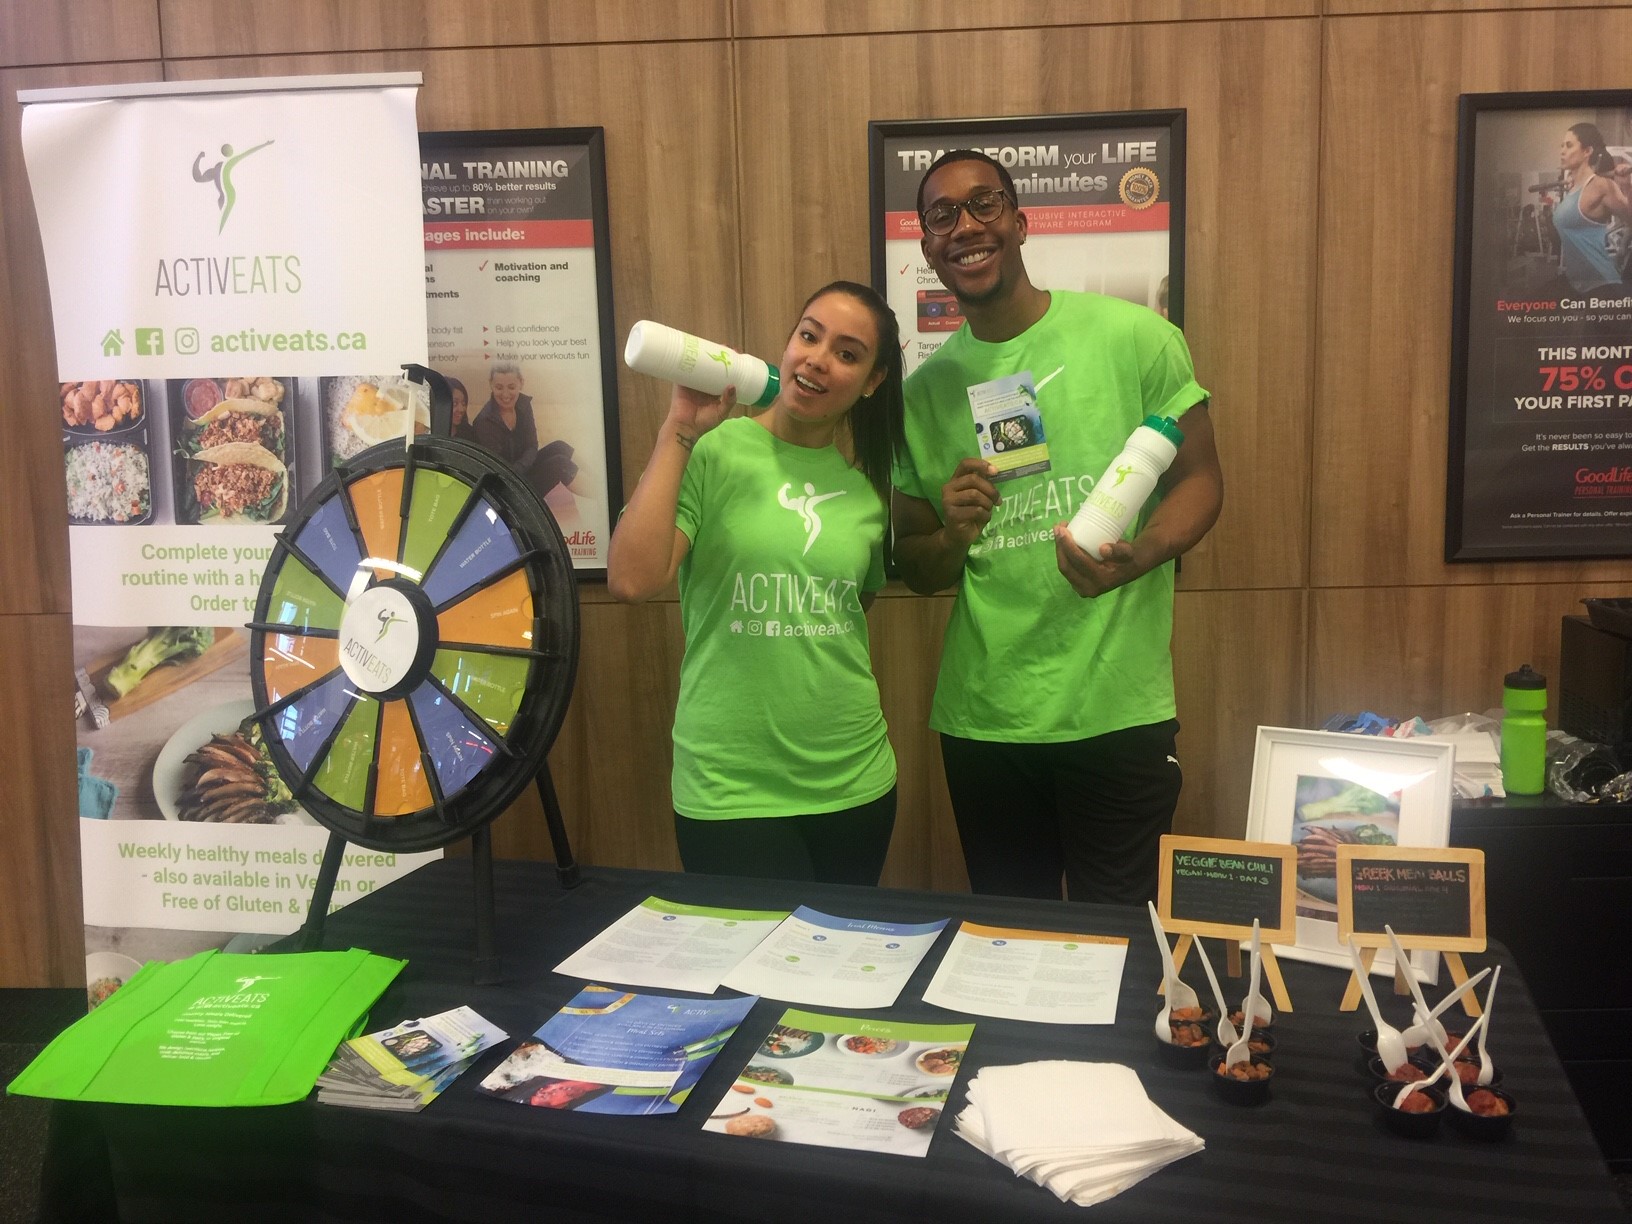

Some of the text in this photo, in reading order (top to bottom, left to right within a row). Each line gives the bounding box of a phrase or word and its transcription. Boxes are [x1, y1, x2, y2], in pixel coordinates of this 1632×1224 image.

[898, 142, 1157, 171] TRFORM your LIFE
[463, 160, 568, 180] TRAINING
[449, 185, 460, 193] up
[462, 184, 470, 192] to
[473, 183, 493, 192] 80%
[495, 183, 523, 191] better
[525, 182, 556, 190] results
[1013, 172, 1108, 194] minutes
[505, 197, 532, 205] working
[500, 207, 515, 215] your
[1068, 209, 1126, 219] INTERACTIVE
[1068, 219, 1112, 228] PROGRAM
[465, 228, 525, 241] include:
[494, 262, 569, 271] Motivation and
[154, 255, 302, 297] ACTIVEATS
[495, 273, 541, 283] coaching
[1496, 296, 1632, 313] Everyone Can Benefi
[1507, 315, 1521, 323] We
[1523, 314, 1547, 323] focus
[1562, 315, 1578, 323] you
[1598, 313, 1614, 322] you
[431, 326, 451, 335] body
[495, 325, 560, 333] Build confidence
[210, 327, 367, 355] activeats.ca
[496, 338, 587, 348] Help you look your best
[438, 354, 459, 362] body
[496, 351, 590, 362] Make your workouts fun
[1538, 345, 1632, 361] THIS MONT
[1538, 365, 1606, 392] 75%
[1514, 396, 1563, 410] YOUR
[1567, 395, 1614, 409] FIRST
[1572, 432, 1592, 440] been
[1605, 432, 1624, 441] easy
[1521, 444, 1536, 452] Get
[1552, 443, 1589, 451] RESULTS
[1590, 442, 1616, 451] you've
[1575, 466, 1632, 483] GoodLife
[141, 543, 272, 564] Complete your
[458, 537, 493, 569] WATER BOTTLE
[571, 548, 597, 556] TRAINING
[121, 568, 244, 586] routine with a
[190, 594, 238, 612] Order
[343, 637, 392, 685] ACTIVEATS
[117, 842, 181, 864] Weekly
[186, 843, 249, 867] healthy
[254, 846, 307, 865] meals
[1175, 854, 1218, 868] VEGGIE
[1218, 859, 1245, 870] BEAN
[153, 868, 376, 892] also available in Vean or
[162, 893, 198, 909] Free
[203, 894, 221, 911] of
[226, 895, 283, 914] Gluten
[288, 898, 300, 914] &
[192, 993, 270, 1007] ACTIVEATS
